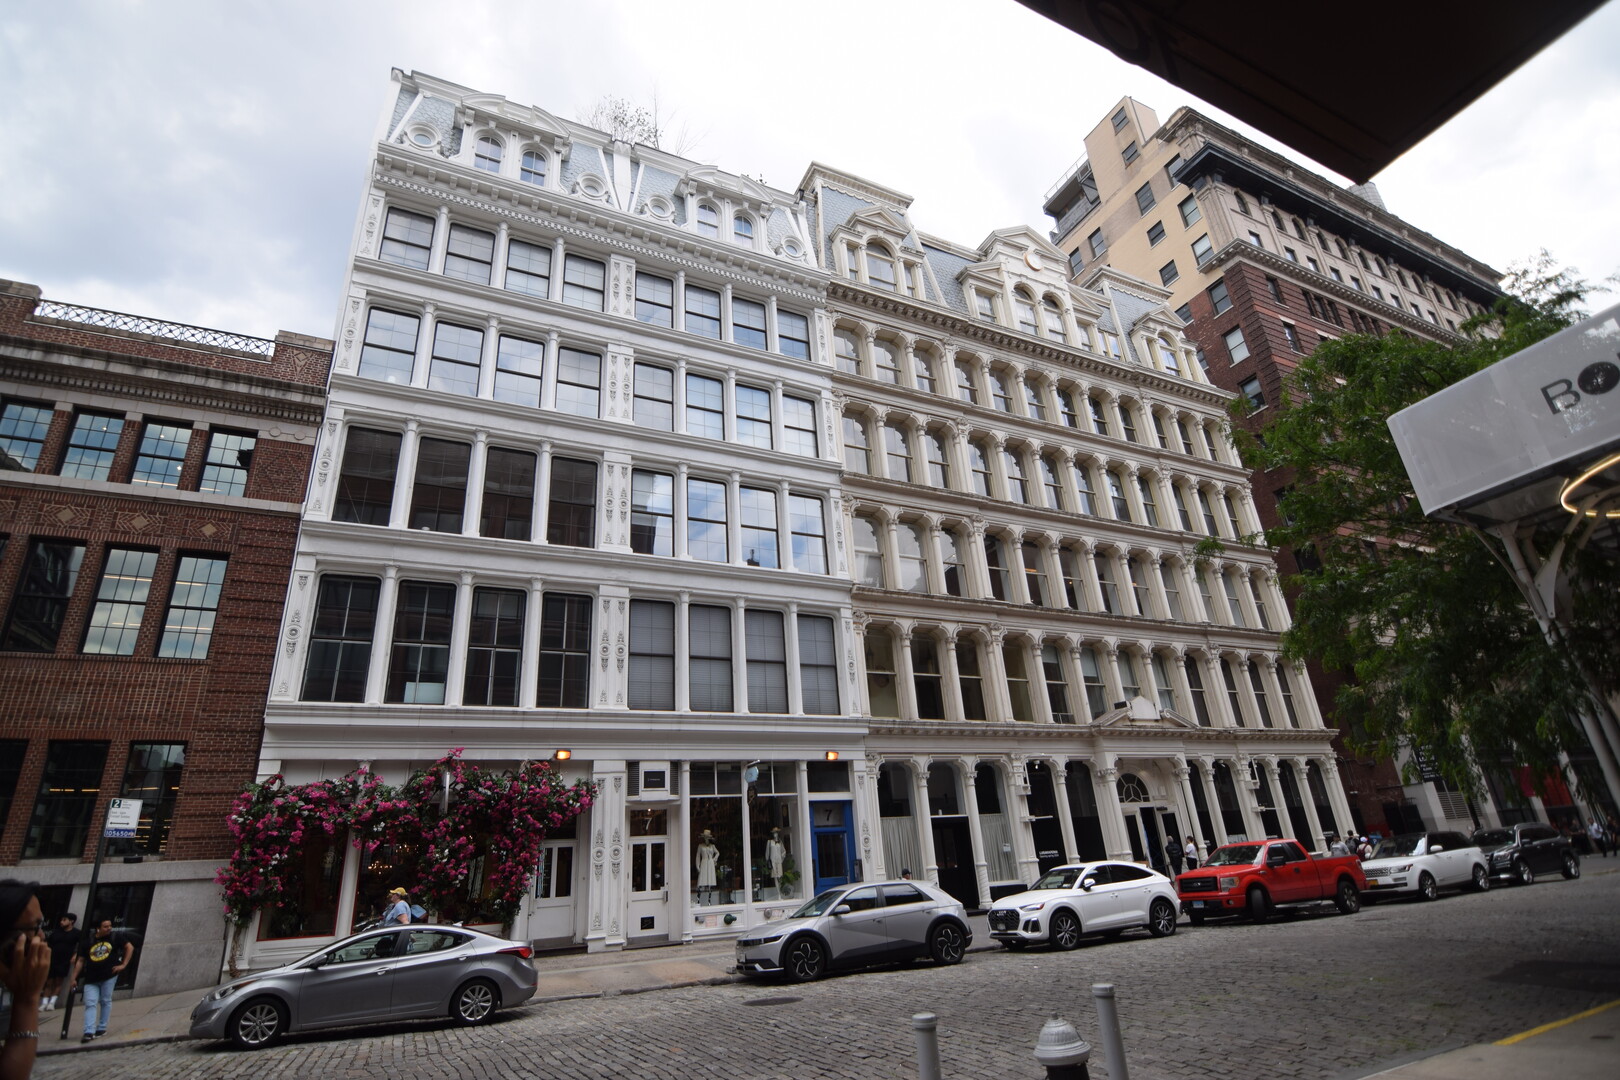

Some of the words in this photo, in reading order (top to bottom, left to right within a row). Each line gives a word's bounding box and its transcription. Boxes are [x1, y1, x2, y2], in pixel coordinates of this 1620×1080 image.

[1541, 353, 1620, 415] BO
[114, 800, 120, 808] 2
[825, 809, 833, 821] 7
[644, 817, 653, 831] 7
